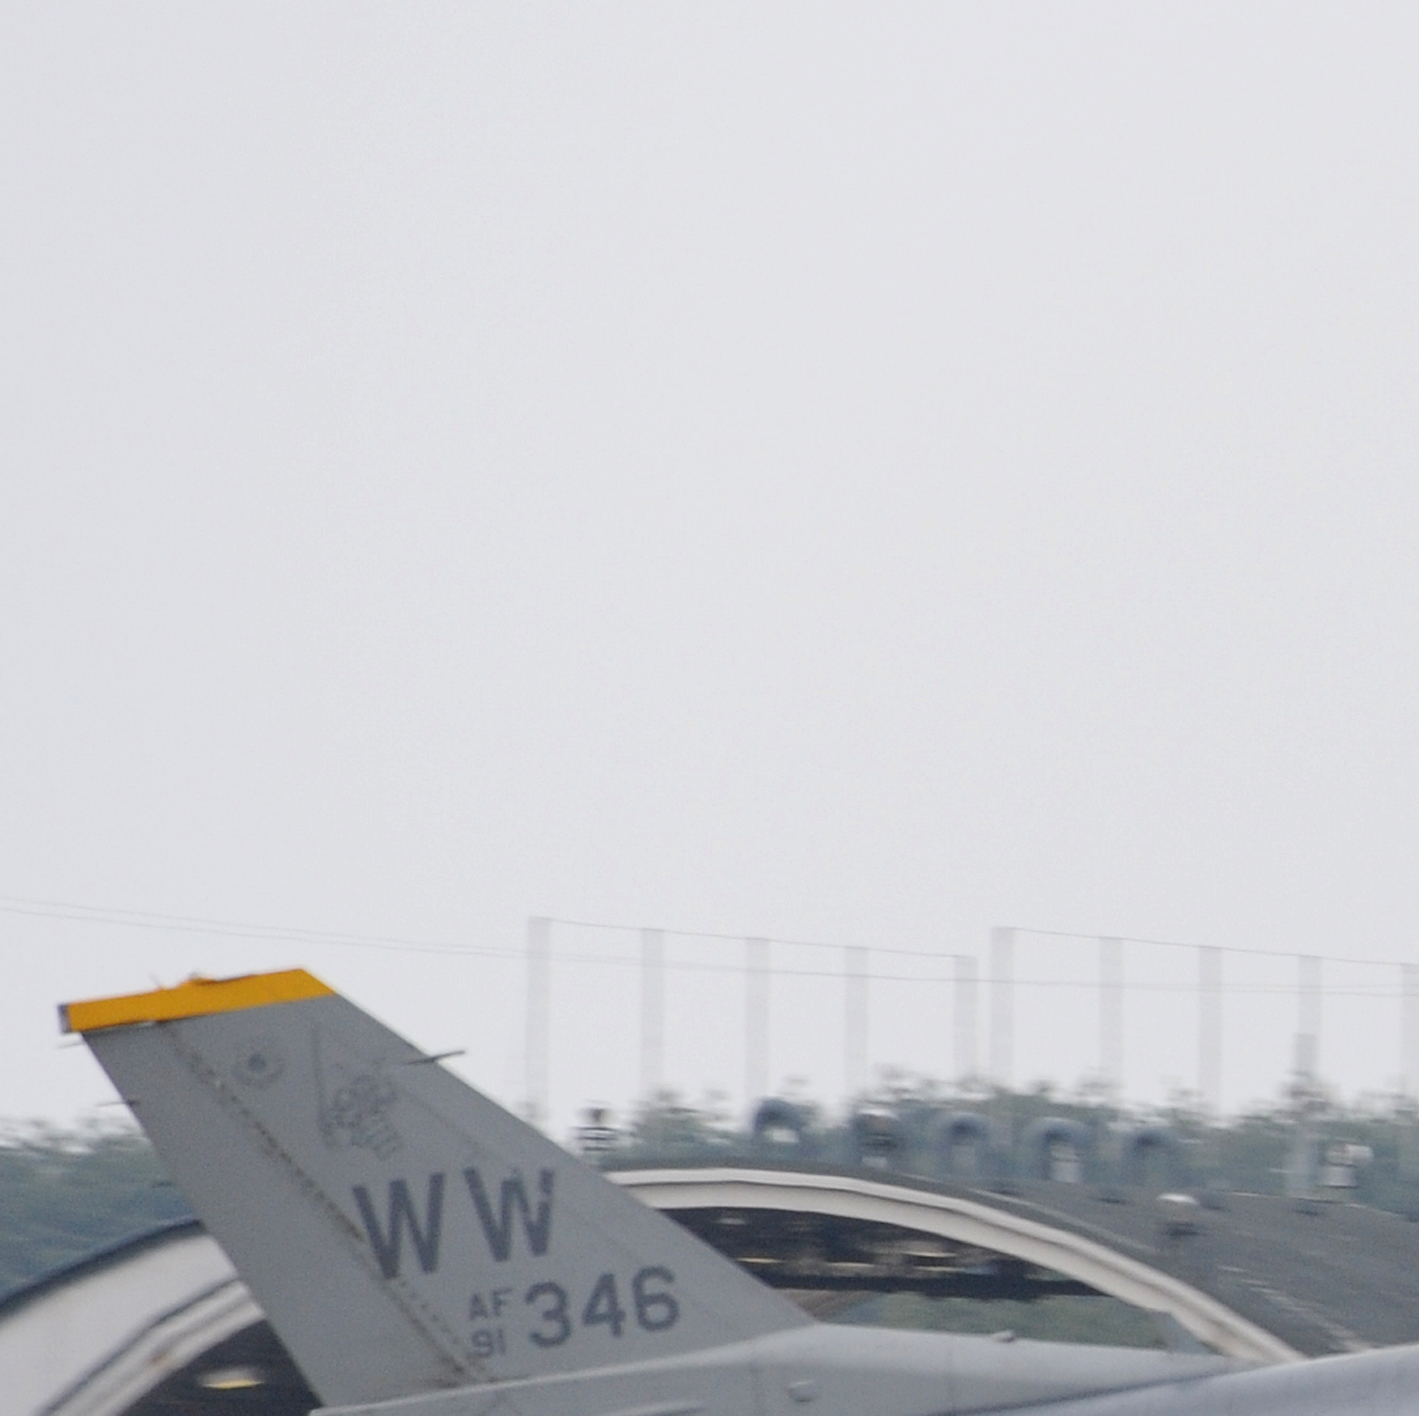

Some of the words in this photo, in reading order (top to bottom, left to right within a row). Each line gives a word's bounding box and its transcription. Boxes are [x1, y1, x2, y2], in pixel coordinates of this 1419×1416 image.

[352, 1166, 555, 1280] WW
[468, 1286, 513, 1320] AF
[523, 1265, 680, 1348] 346
[470, 1328, 506, 1359] 91
